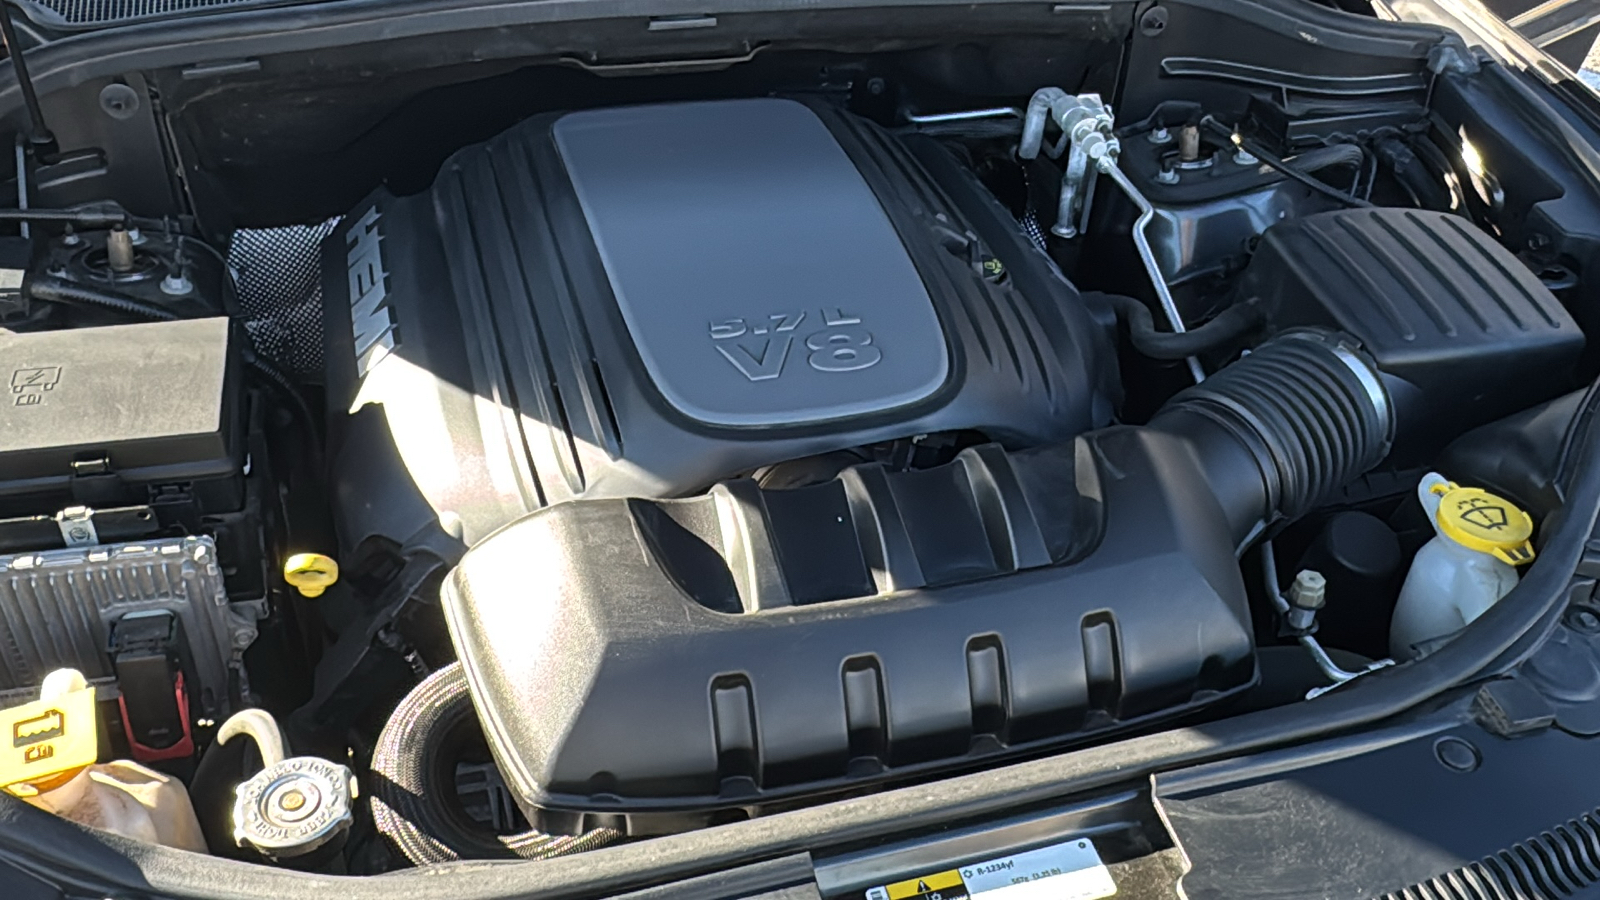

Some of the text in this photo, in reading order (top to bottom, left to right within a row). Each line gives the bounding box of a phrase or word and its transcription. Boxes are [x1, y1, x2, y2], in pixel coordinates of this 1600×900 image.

[346, 205, 396, 379] HEMI
[709, 307, 862, 339] 5.7 L
[714, 329, 883, 382] V8
[976, 859, 1015, 876] R-1234yf
